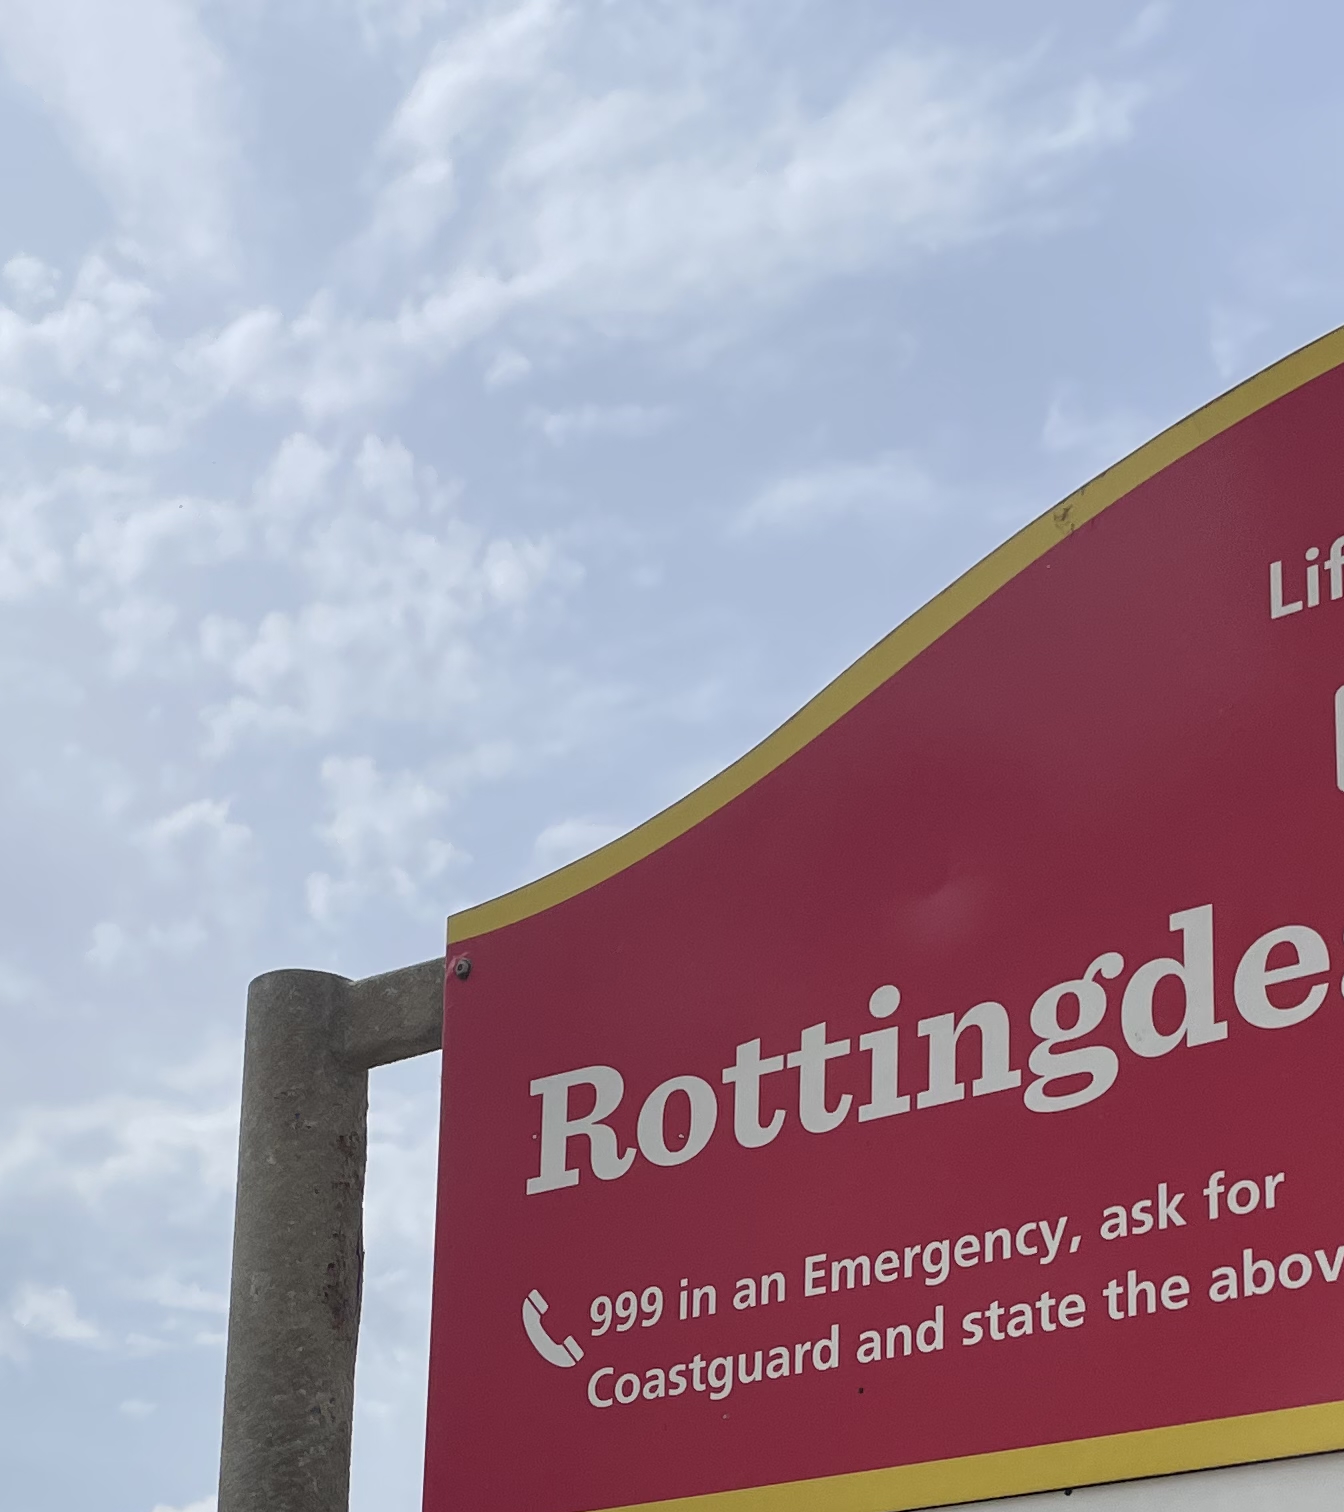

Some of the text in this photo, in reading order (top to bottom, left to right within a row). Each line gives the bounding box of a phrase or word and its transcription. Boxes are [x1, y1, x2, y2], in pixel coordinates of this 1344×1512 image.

[591, 1171, 1284, 1336] 999 in an Emergency, ask for
[587, 1324, 841, 1409] Coastguard
[857, 1306, 943, 1363] and
[963, 1292, 1085, 1345] state
[1103, 1270, 1189, 1319] the
